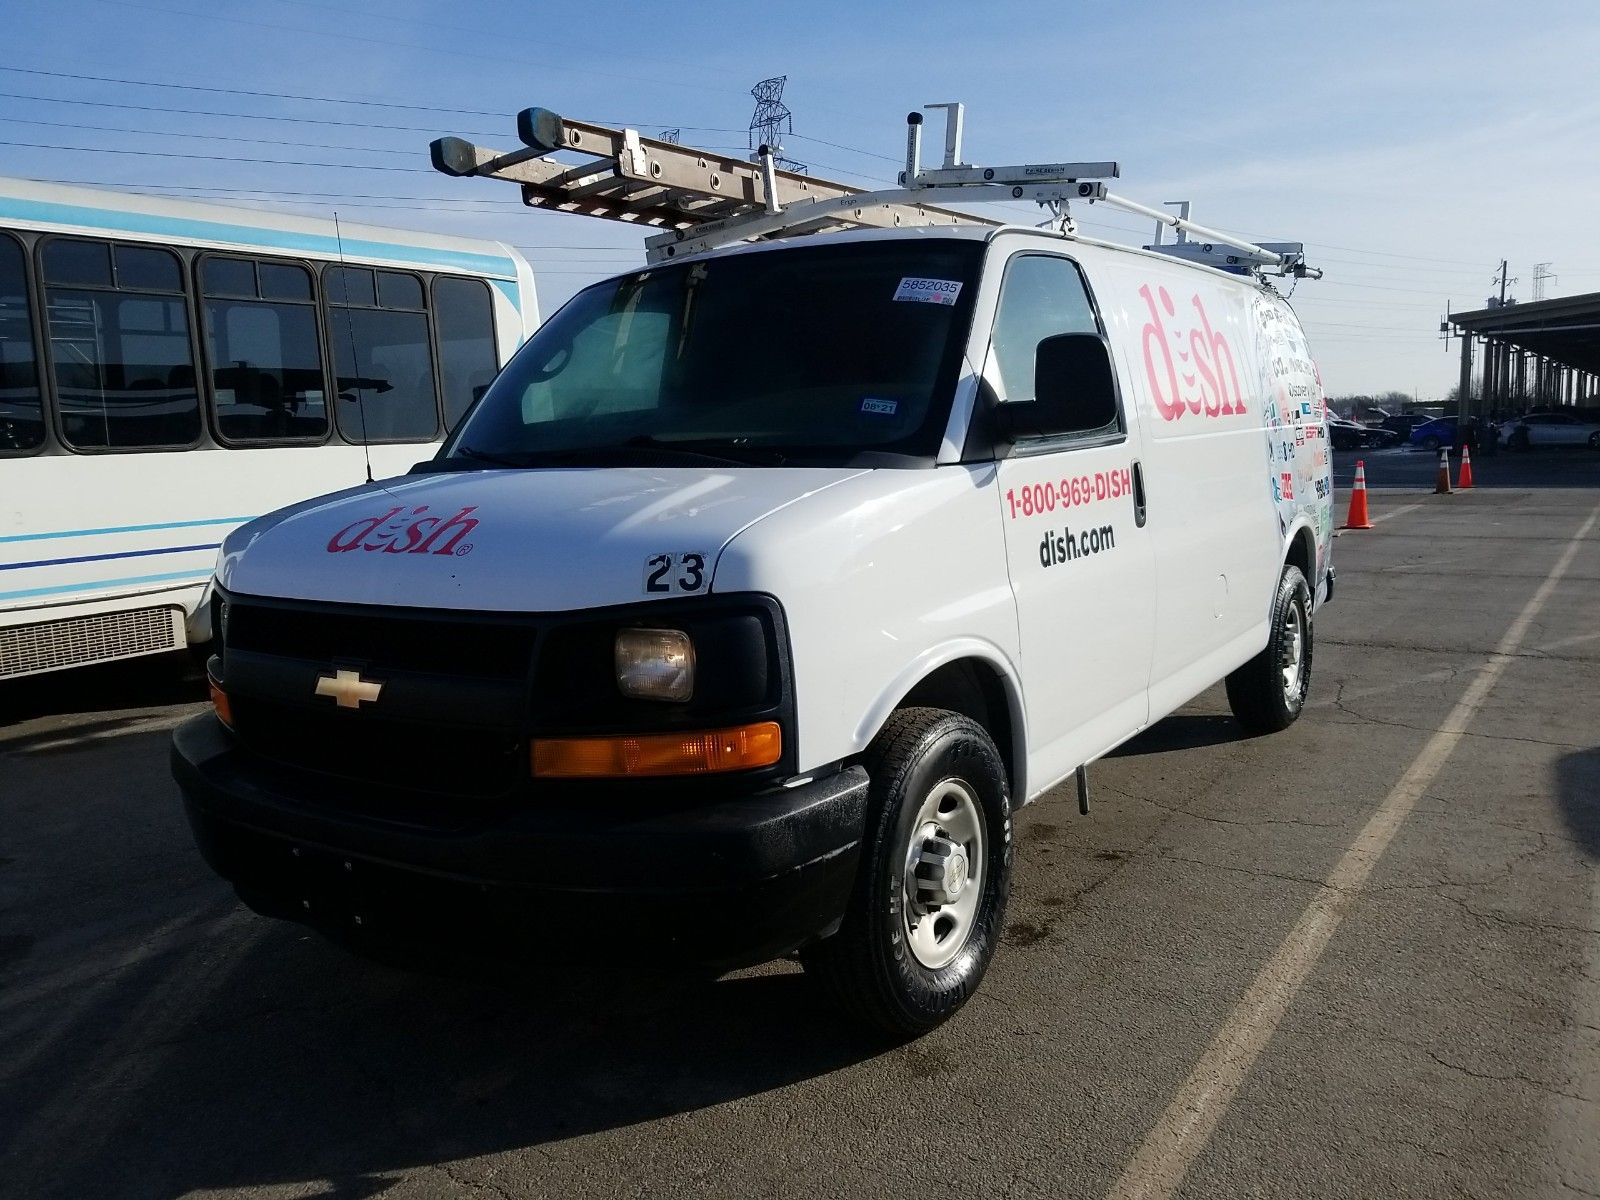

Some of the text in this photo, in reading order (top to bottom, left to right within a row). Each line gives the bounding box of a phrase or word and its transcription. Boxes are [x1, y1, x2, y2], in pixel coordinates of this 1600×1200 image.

[902, 280, 958, 293] 5852035
[1138, 283, 1246, 421] dish
[1006, 468, 1132, 519] 1-800-969-DISH
[1039, 524, 1116, 568] dish.com
[647, 553, 704, 592] 23
